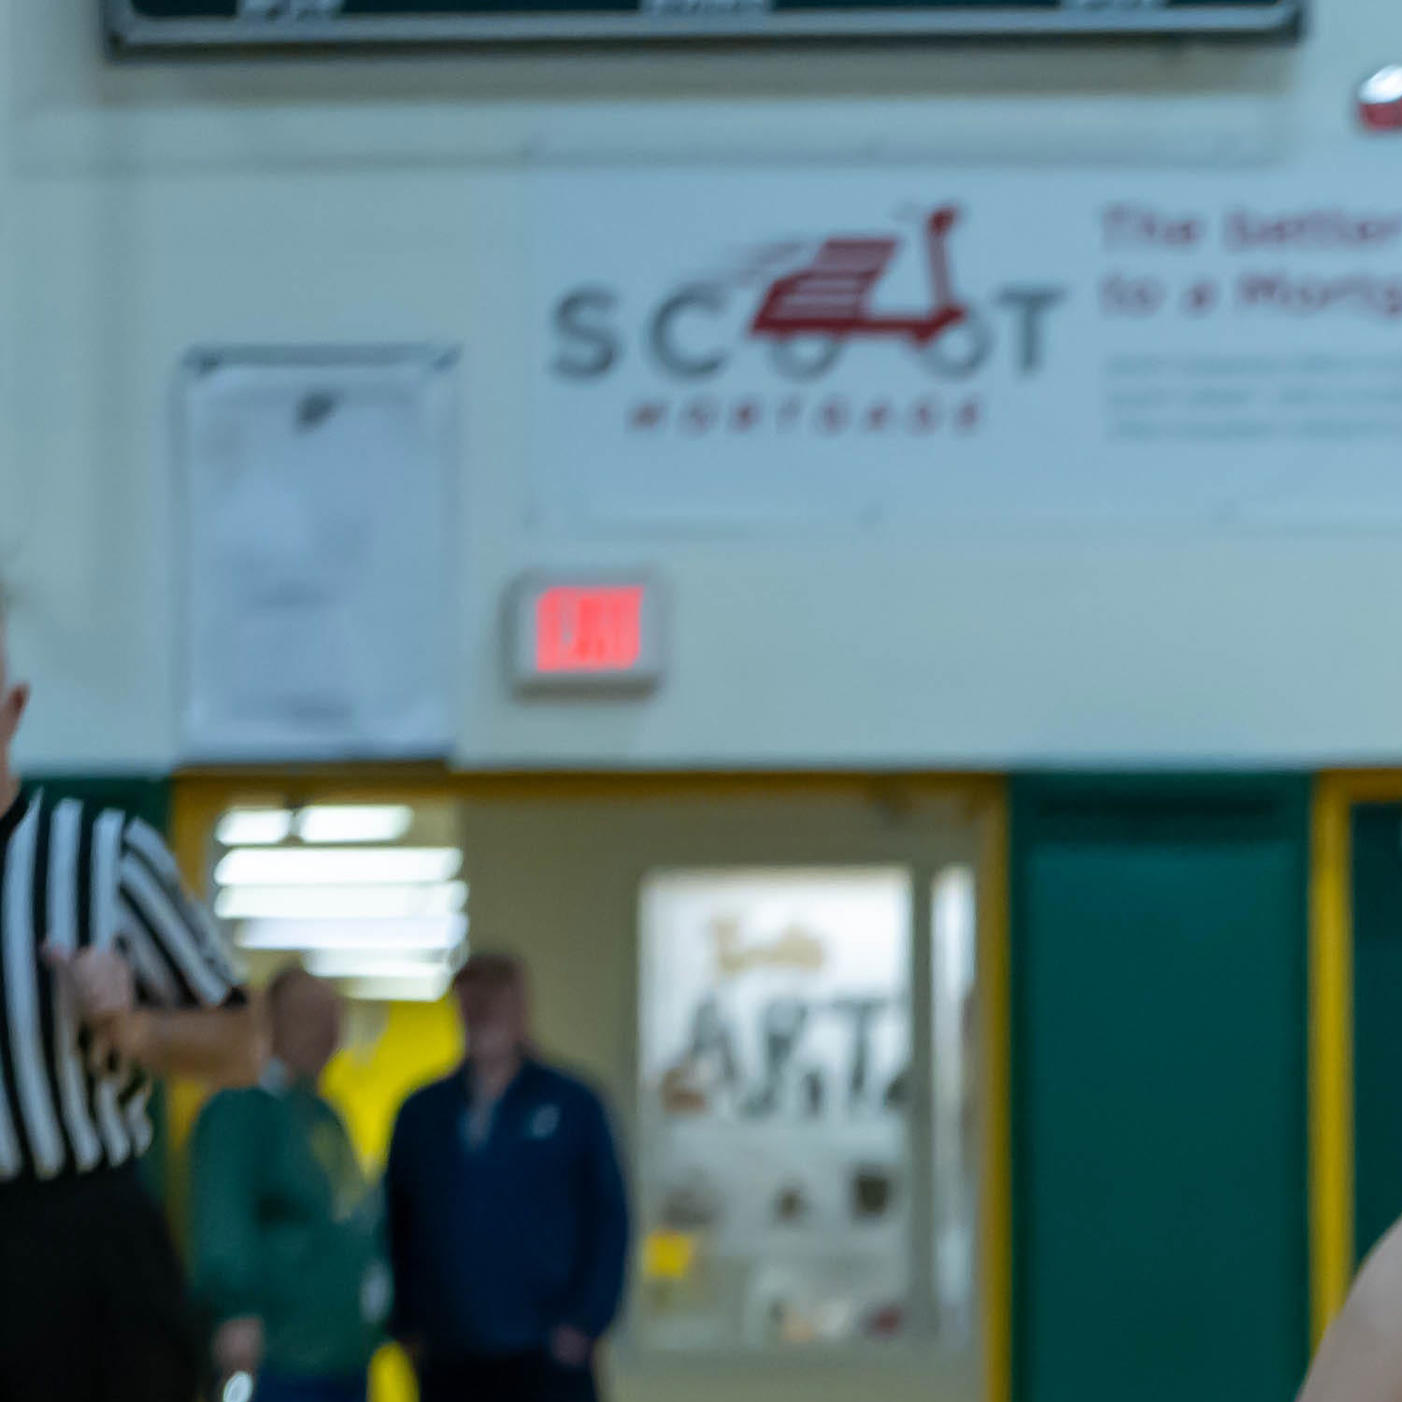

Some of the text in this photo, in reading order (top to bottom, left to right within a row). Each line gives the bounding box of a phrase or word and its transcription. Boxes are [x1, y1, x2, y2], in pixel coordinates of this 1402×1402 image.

[1101, 207, 1205, 250] The
[1101, 272, 1166, 314] to
[1182, 278, 1220, 314] a
